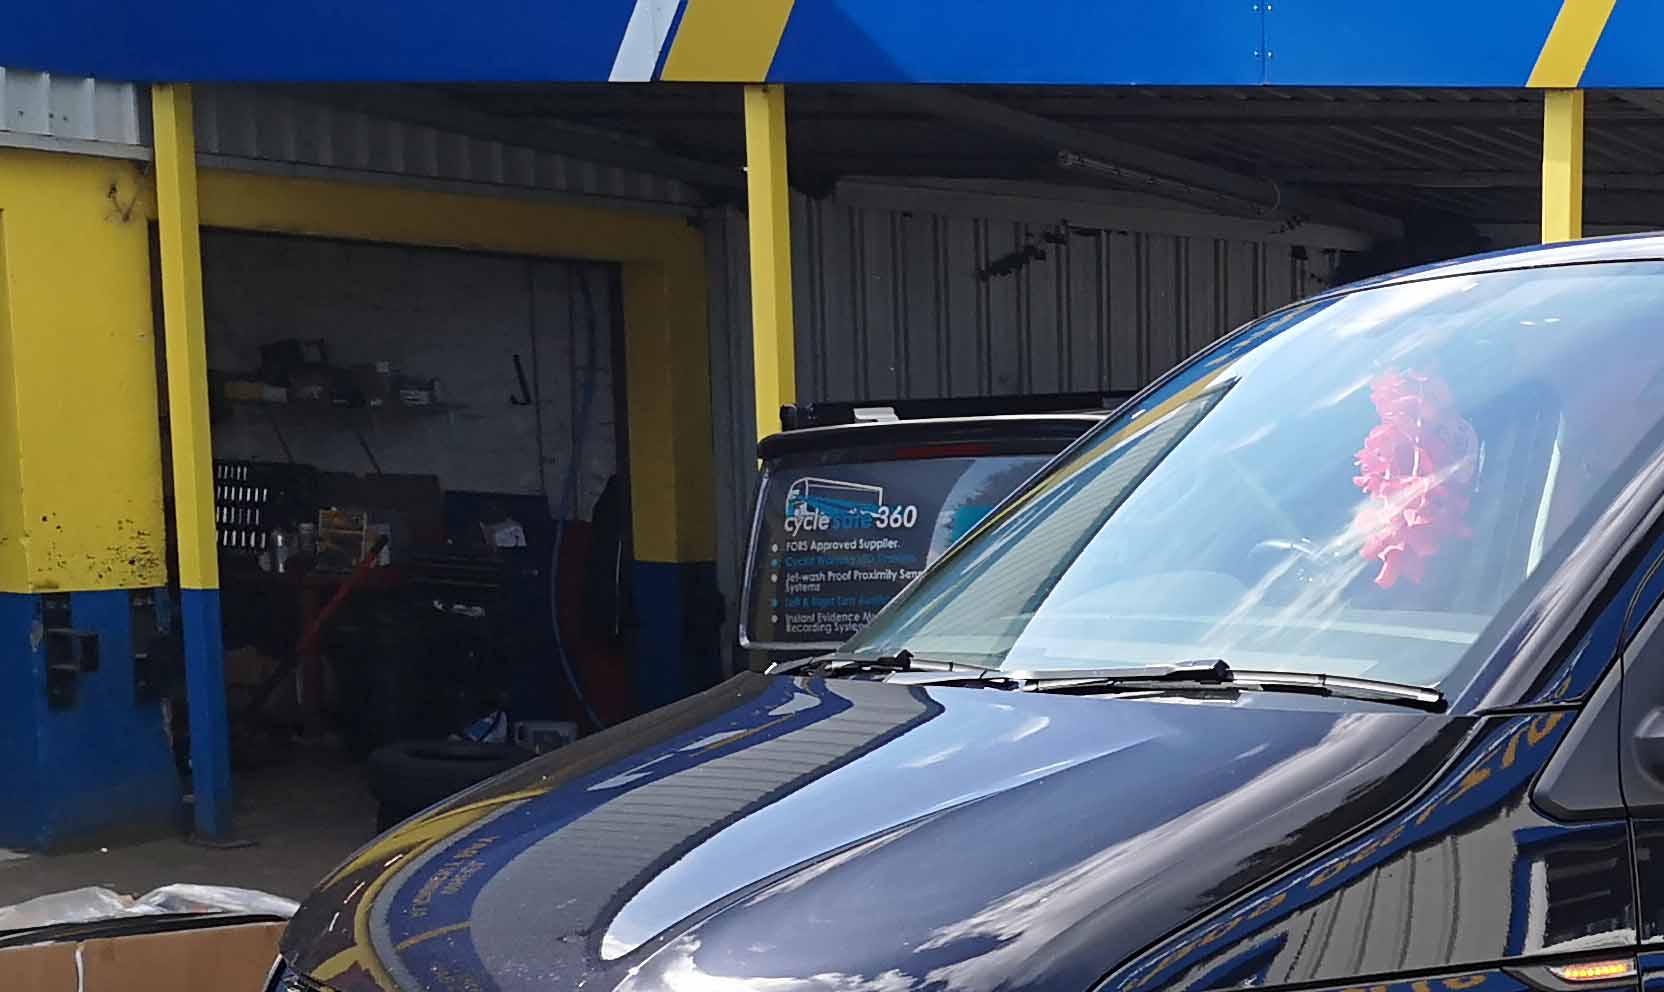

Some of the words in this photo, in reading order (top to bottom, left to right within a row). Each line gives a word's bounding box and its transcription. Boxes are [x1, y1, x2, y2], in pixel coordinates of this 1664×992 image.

[810, 540, 857, 553] Approved
[827, 570, 851, 581] Proof
[853, 567, 897, 582] Proximity
[817, 611, 860, 623] Evidence
